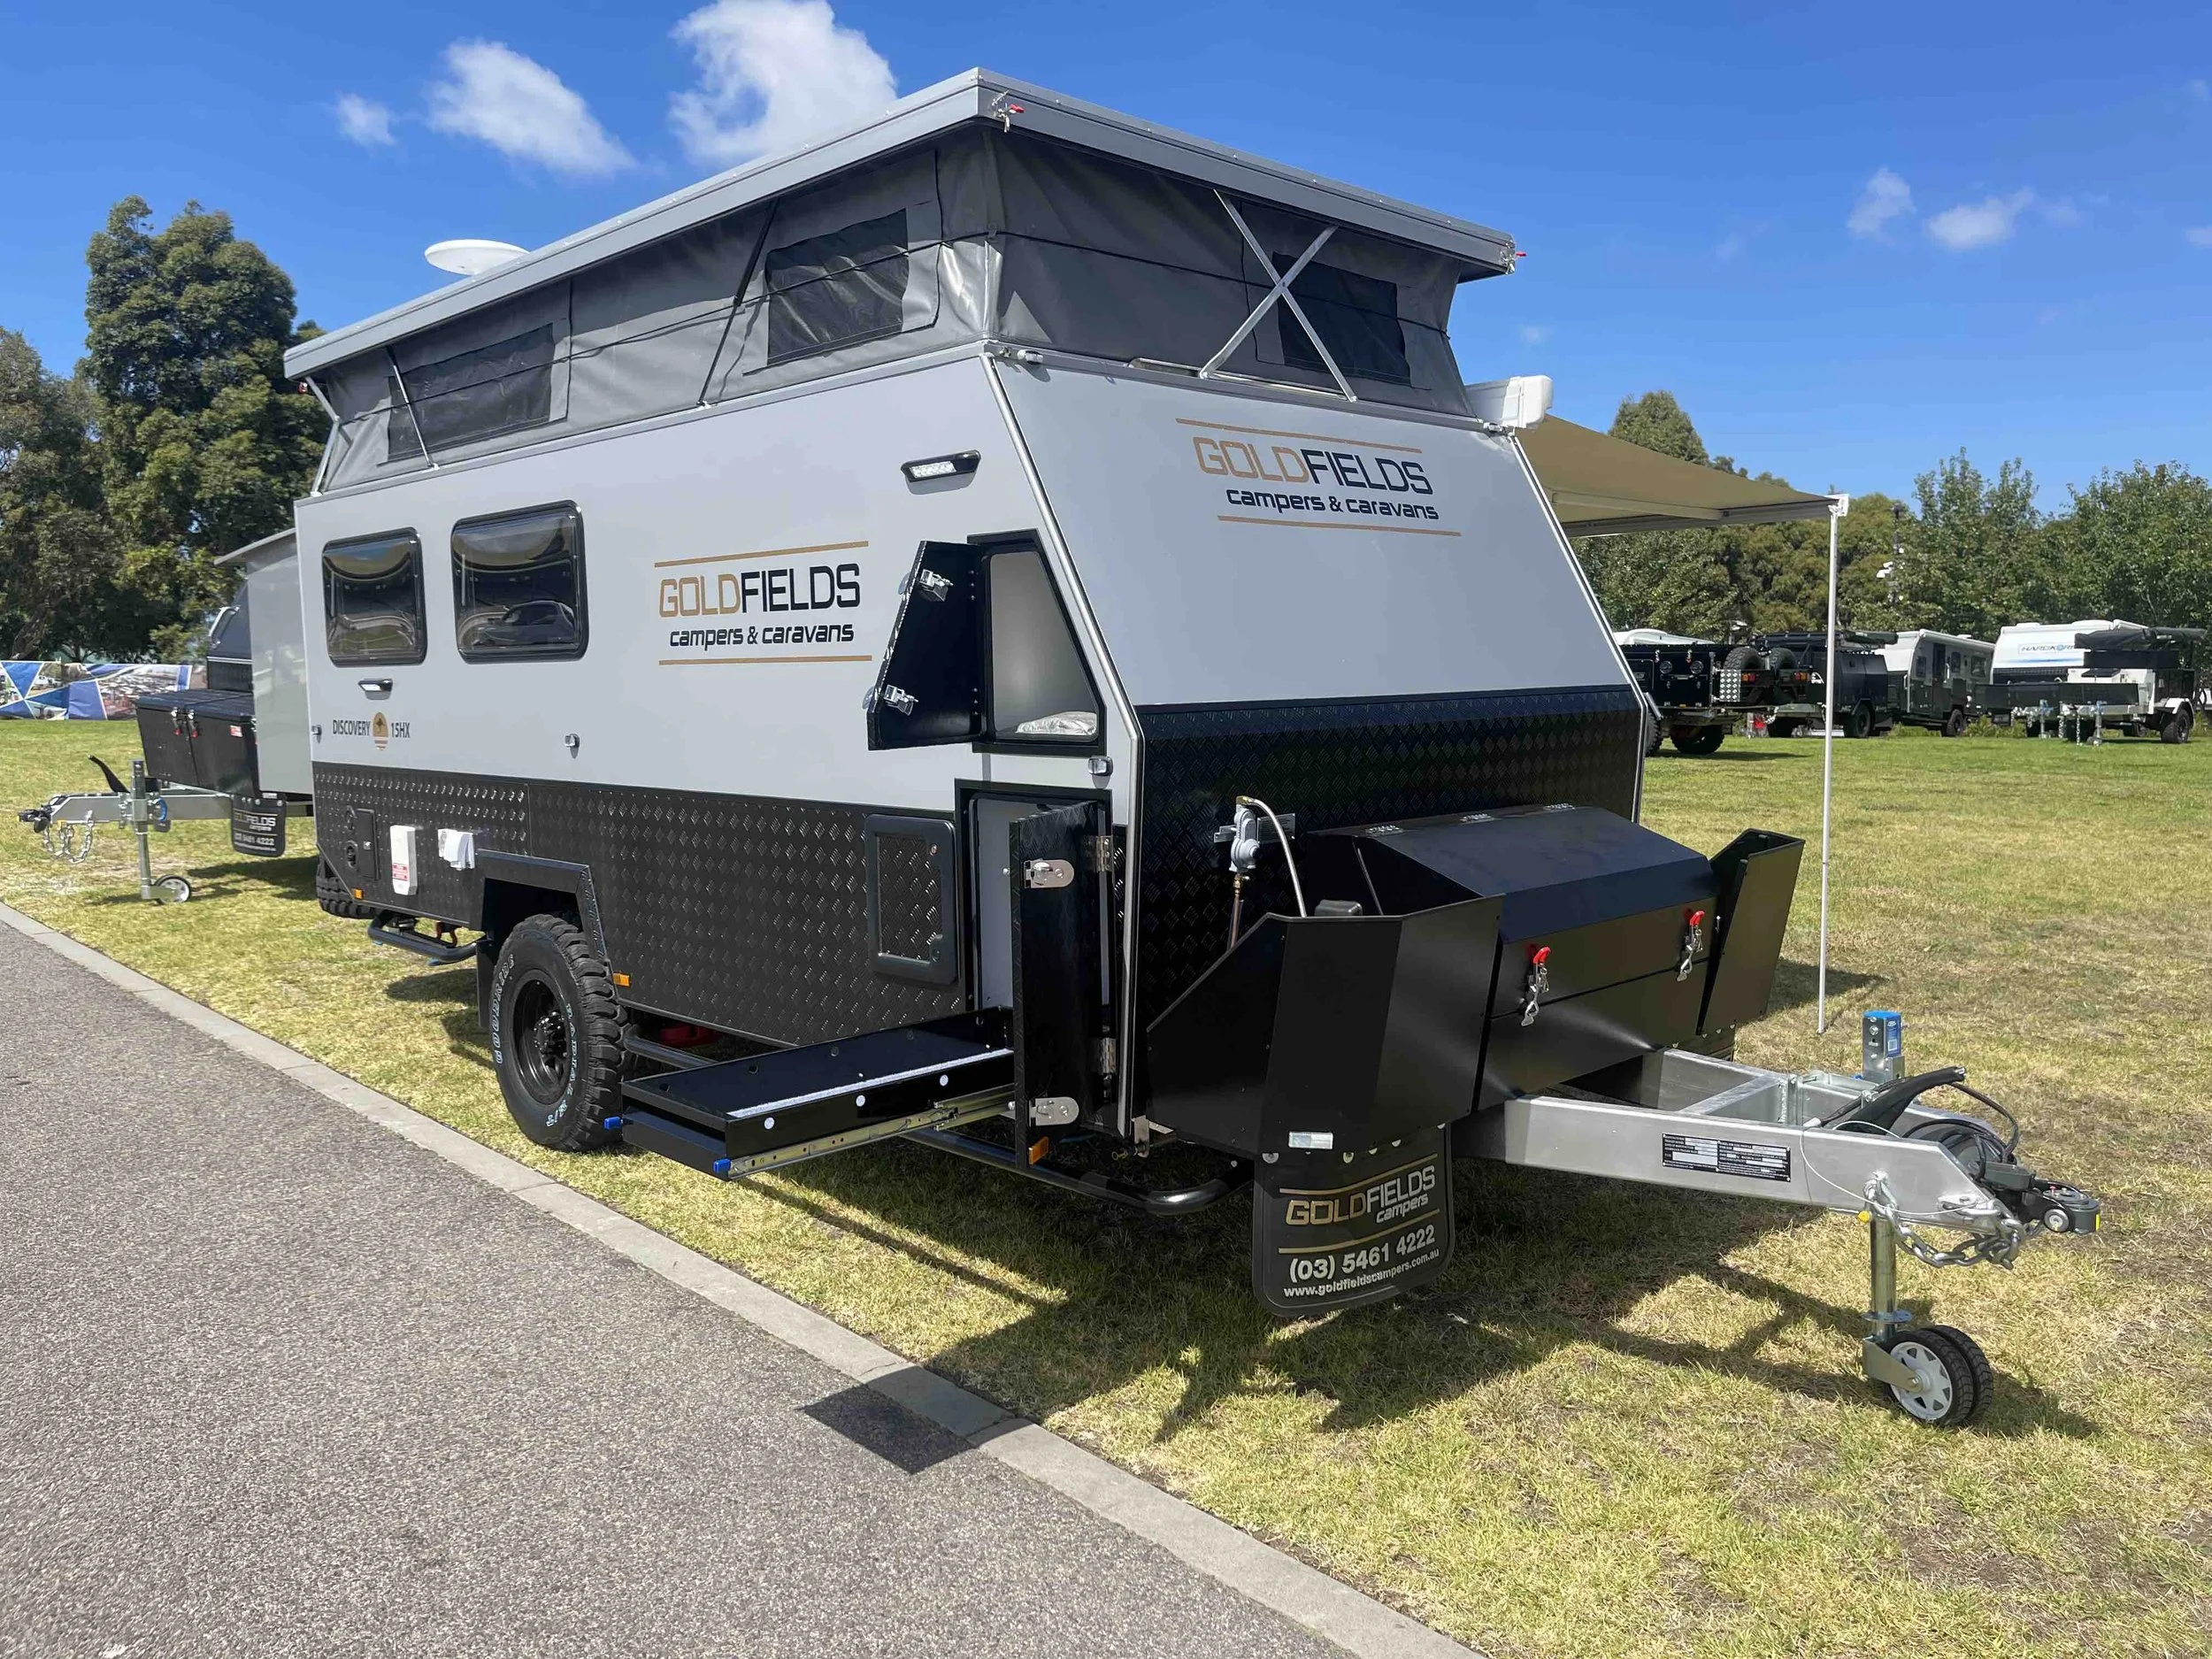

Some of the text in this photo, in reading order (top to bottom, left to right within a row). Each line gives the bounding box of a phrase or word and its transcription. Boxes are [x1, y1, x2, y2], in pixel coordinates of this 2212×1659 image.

[1193, 437, 1433, 495] GOLDFIELDS
[1225, 489, 1440, 520] campers & caravans
[659, 563, 860, 618] GOLDFIELDS
[670, 624, 854, 651] campers & caravans
[333, 719, 411, 738] DISCOVERY 15HX
[1286, 1165, 1435, 1225] GOLDFIELDS
[1376, 1193, 1429, 1223] campers
[1284, 1248, 1440, 1297] www.goldfieldscampers.com.au
[1289, 1225, 1435, 1283] (03) 5461 4222
